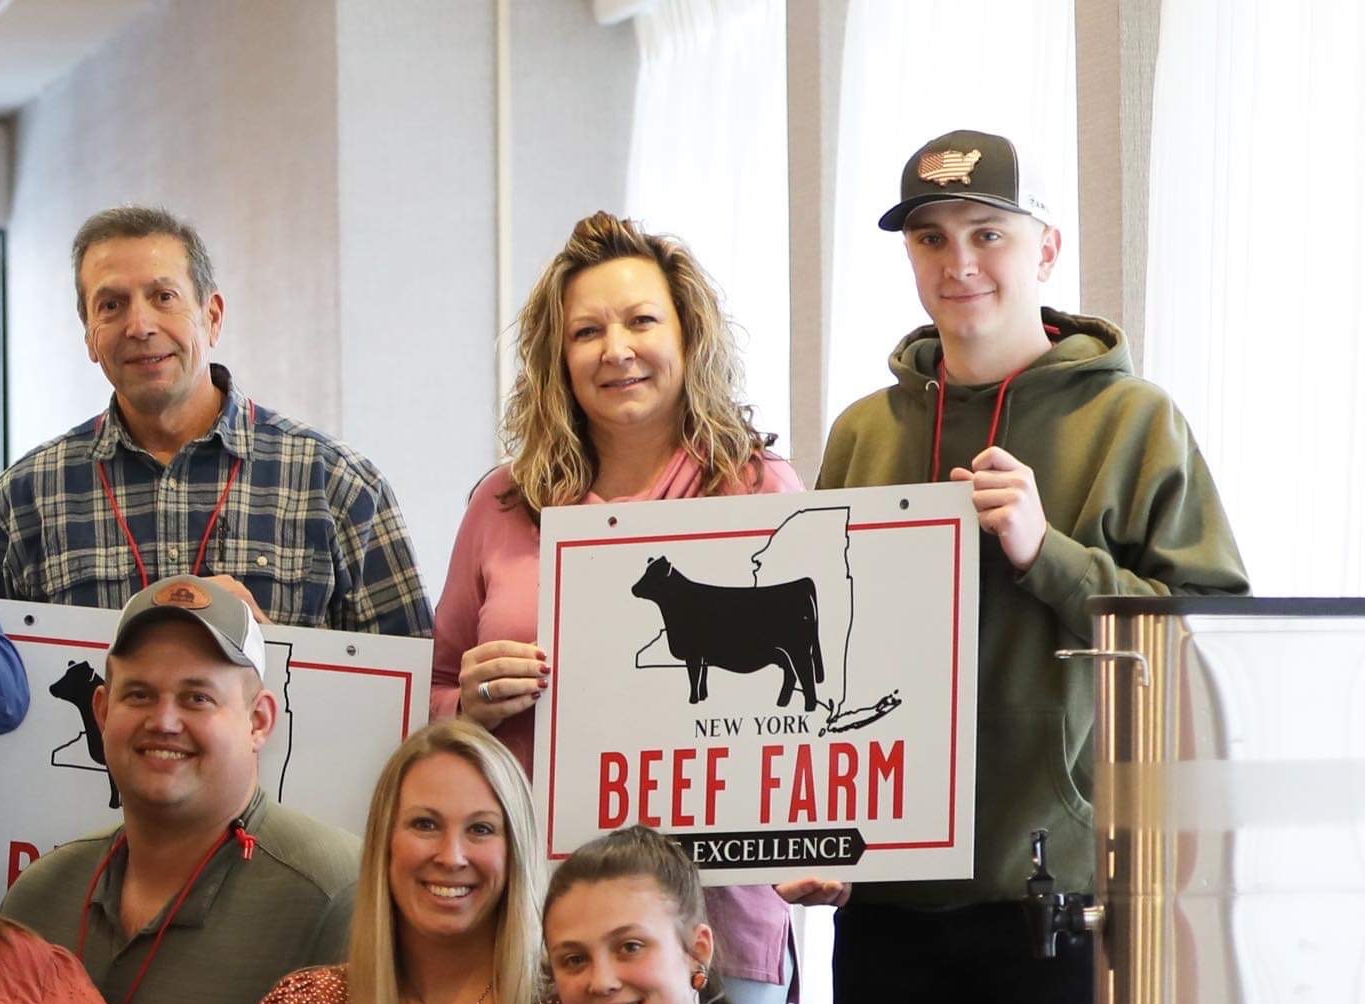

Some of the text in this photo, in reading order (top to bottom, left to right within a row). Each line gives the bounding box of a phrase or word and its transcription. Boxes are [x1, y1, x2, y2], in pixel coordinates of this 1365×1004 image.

[694, 714, 811, 739] NEW YORK
[597, 739, 906, 830] BEEF FARM
[692, 836, 853, 864] EXCELLENCE
